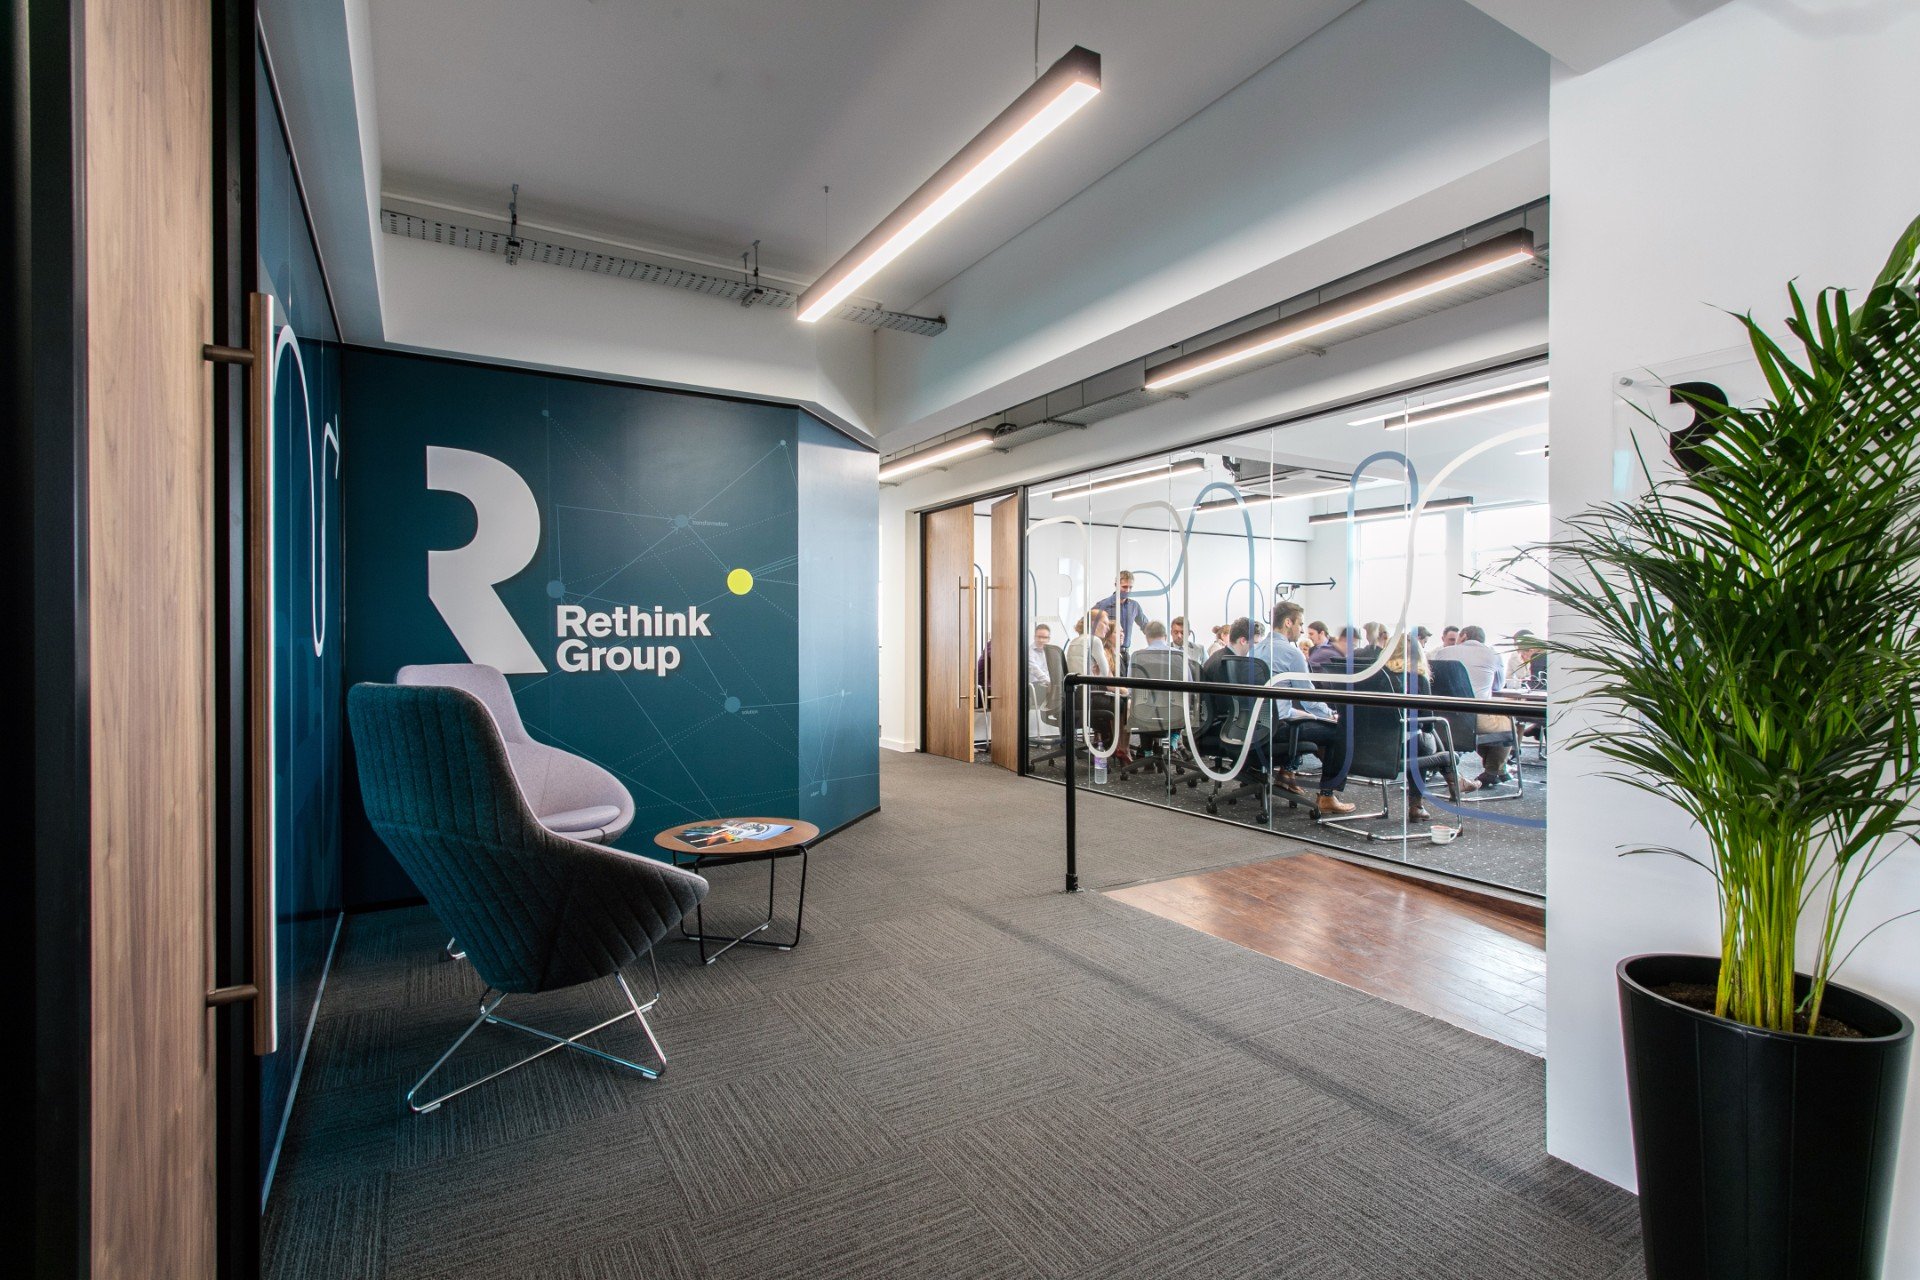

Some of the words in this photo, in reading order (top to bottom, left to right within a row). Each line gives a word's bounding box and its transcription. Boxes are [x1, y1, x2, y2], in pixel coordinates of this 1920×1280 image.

[426, 445, 548, 674] R
[557, 604, 711, 637] Rethink
[556, 638, 681, 676] Group
